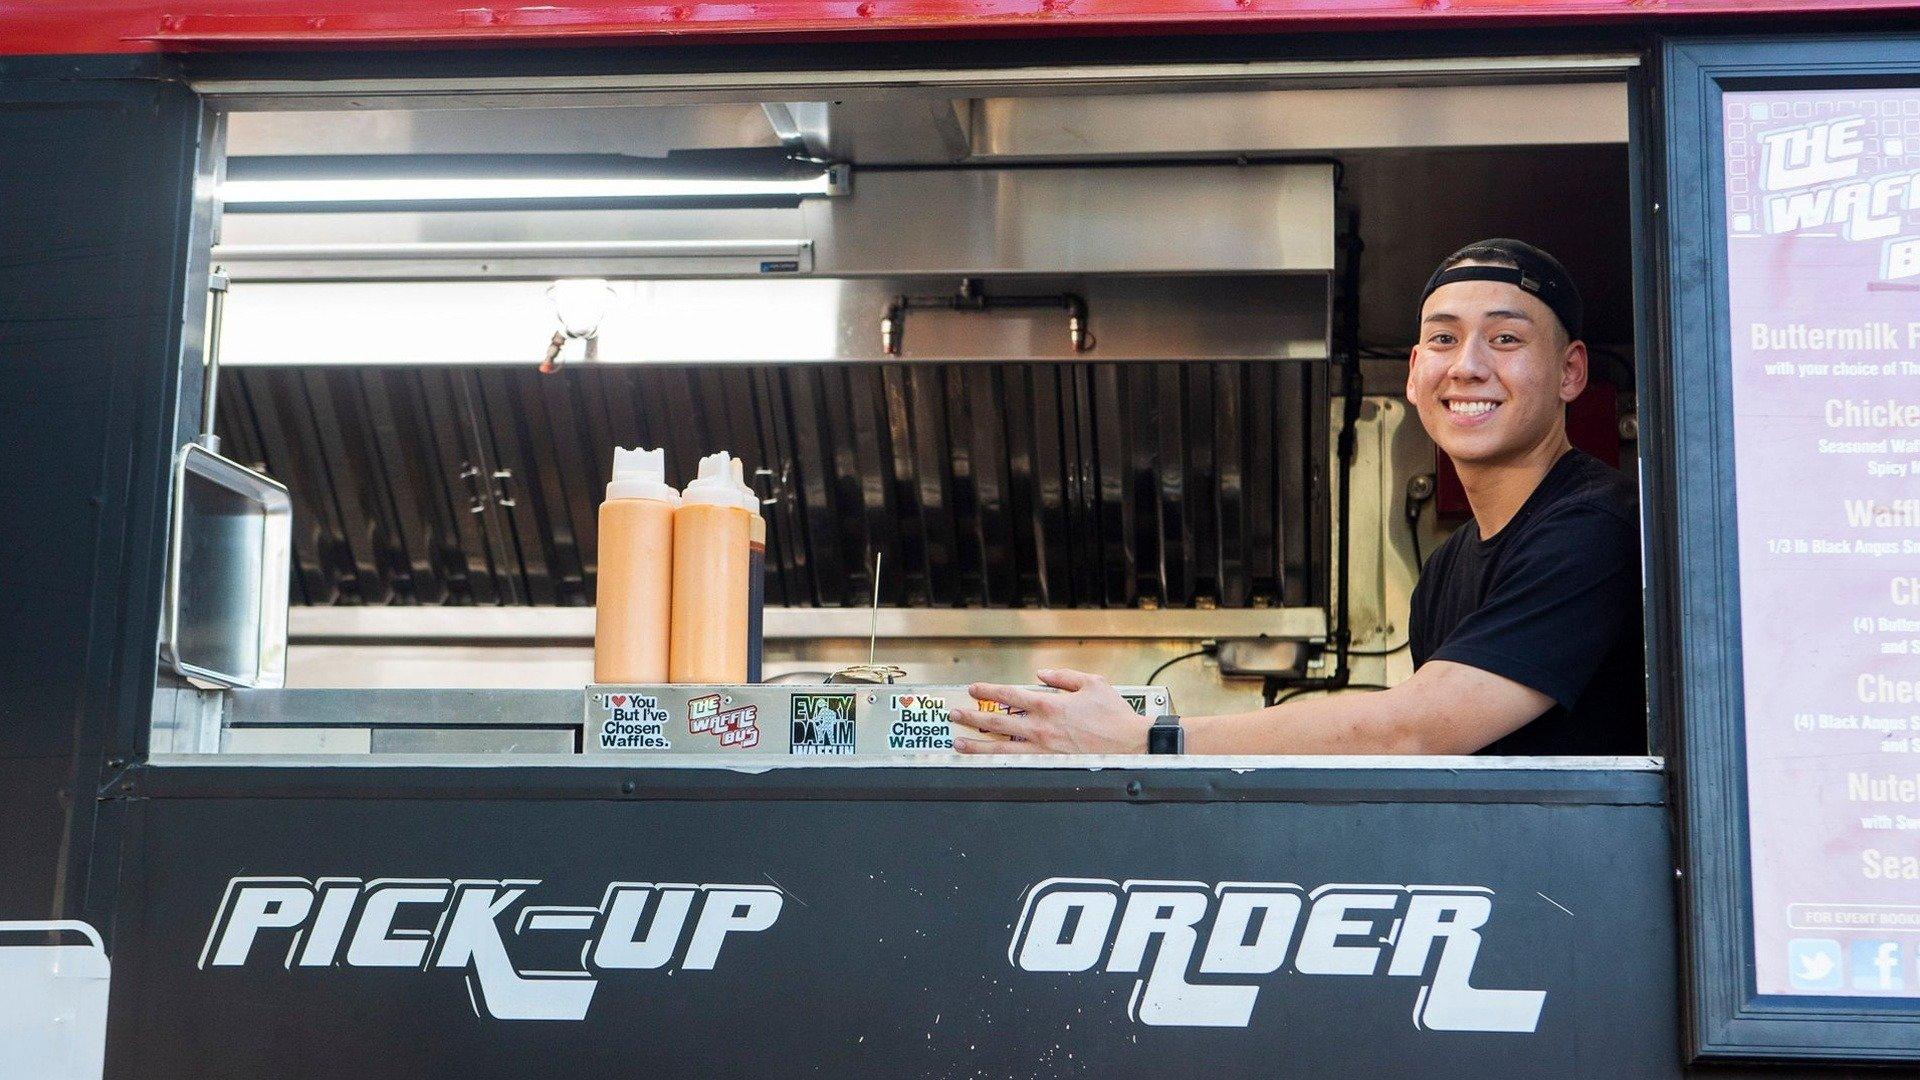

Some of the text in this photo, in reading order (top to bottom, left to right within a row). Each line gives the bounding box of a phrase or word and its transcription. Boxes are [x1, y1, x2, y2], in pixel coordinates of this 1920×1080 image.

[1757, 114, 1866, 191] THE
[1751, 323, 1899, 350] Buttermilk
[1765, 362, 1794, 376] with
[1799, 364, 1829, 378] your
[1832, 362, 1879, 376] choice
[1882, 361, 1897, 375] of
[1825, 399, 1920, 427] Chicke
[1819, 439, 1887, 453] Seasoned
[1867, 460, 1907, 477] Spicy
[1767, 539, 1790, 554] 1/3
[1812, 539, 1851, 553] Black
[1854, 539, 1900, 557] Angus
[1854, 616, 1874, 634] (4)
[1881, 640, 1908, 654] and
[605, 695, 656, 708] I You
[689, 696, 720, 718] THE
[892, 696, 943, 709] I You
[613, 708, 667, 721] But I've
[690, 707, 756, 734] WAFFLE
[901, 710, 928, 722] But
[604, 721, 661, 735] Chosen
[892, 723, 950, 736] Chosen
[1794, 714, 1815, 732] (4)
[1819, 714, 1860, 730] Black
[1861, 715, 1907, 733] Angus
[601, 735, 669, 747] Waffles.
[722, 727, 758, 747] BUS
[1881, 739, 1908, 753] and
[1861, 815, 1892, 830] with
[1806, 911, 1832, 924] FOR
[1835, 911, 1877, 924] EVENT
[198, 876, 784, 1021] PICK-UP
[1008, 877, 1547, 1033] ORDER
